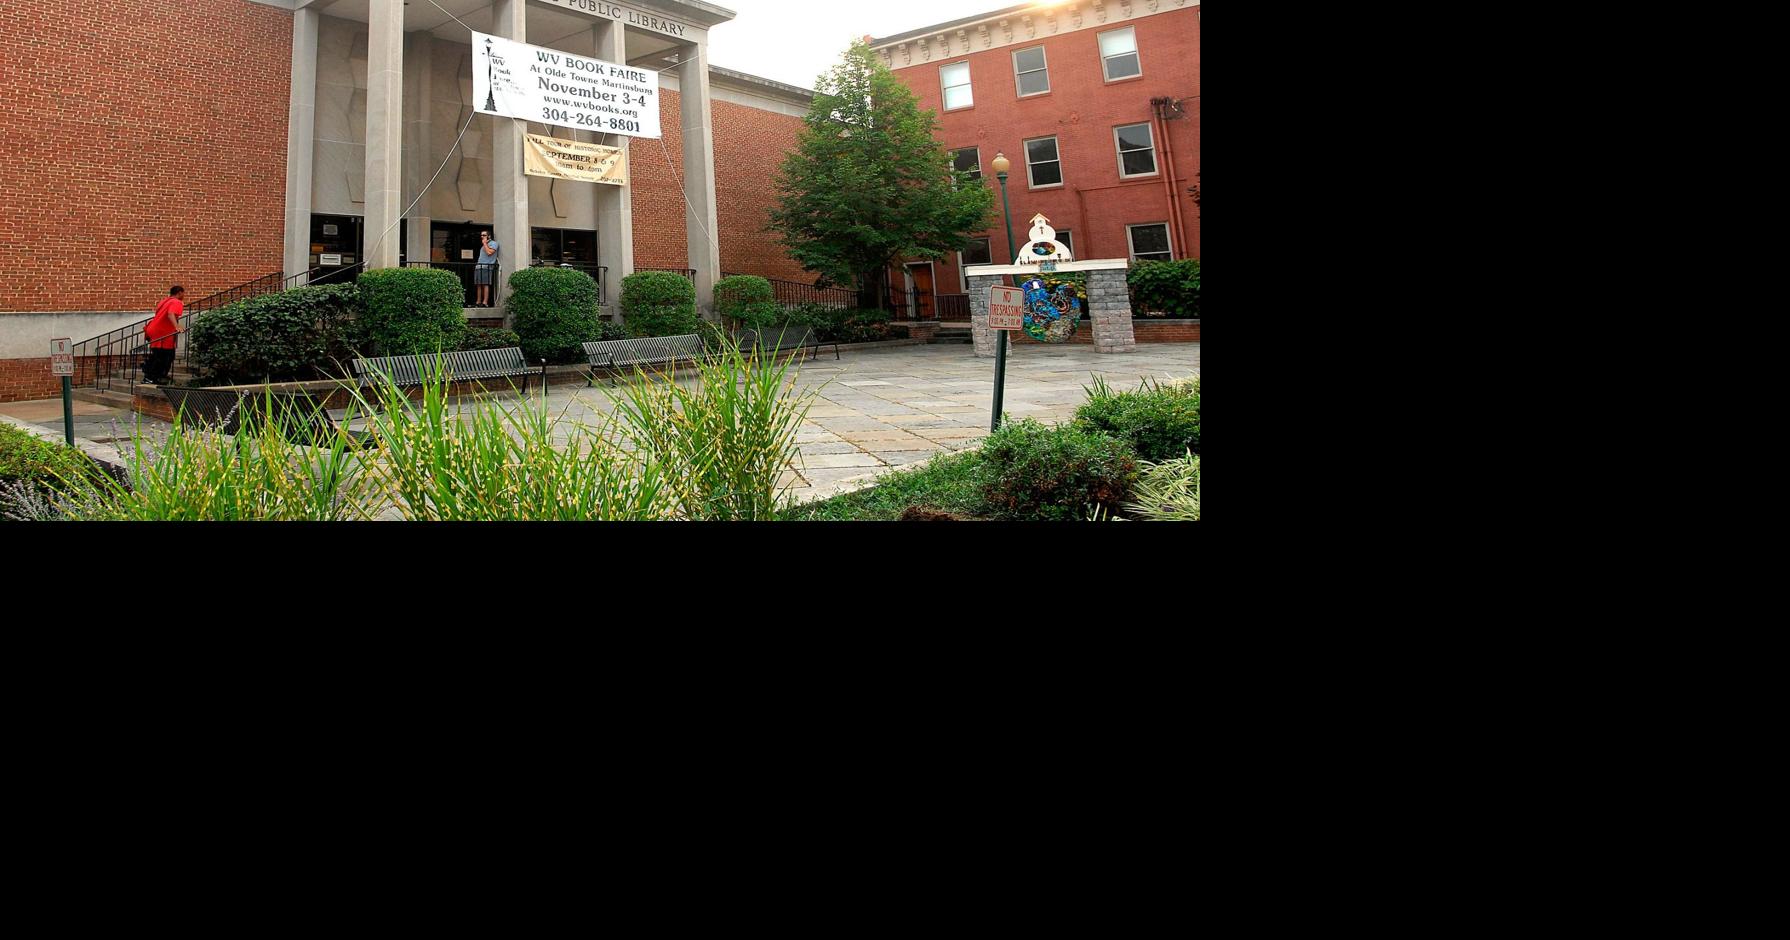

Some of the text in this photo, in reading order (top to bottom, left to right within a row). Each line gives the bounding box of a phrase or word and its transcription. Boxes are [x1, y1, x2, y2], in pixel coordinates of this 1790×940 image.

[569, 0, 685, 36] PUBLIC LIBRARY
[530, 64, 653, 95] At Olde Towne Martinsburg
[536, 50, 647, 83] WV BOOK FAIRE
[538, 76, 617, 102] November
[622, 92, 646, 107] 3-4
[542, 107, 641, 133] 304-264-8801
[543, 95, 638, 118] www.wvbooks.org
[991, 304, 1021, 317] TRESPASSING
[1003, 291, 1011, 303] NO
